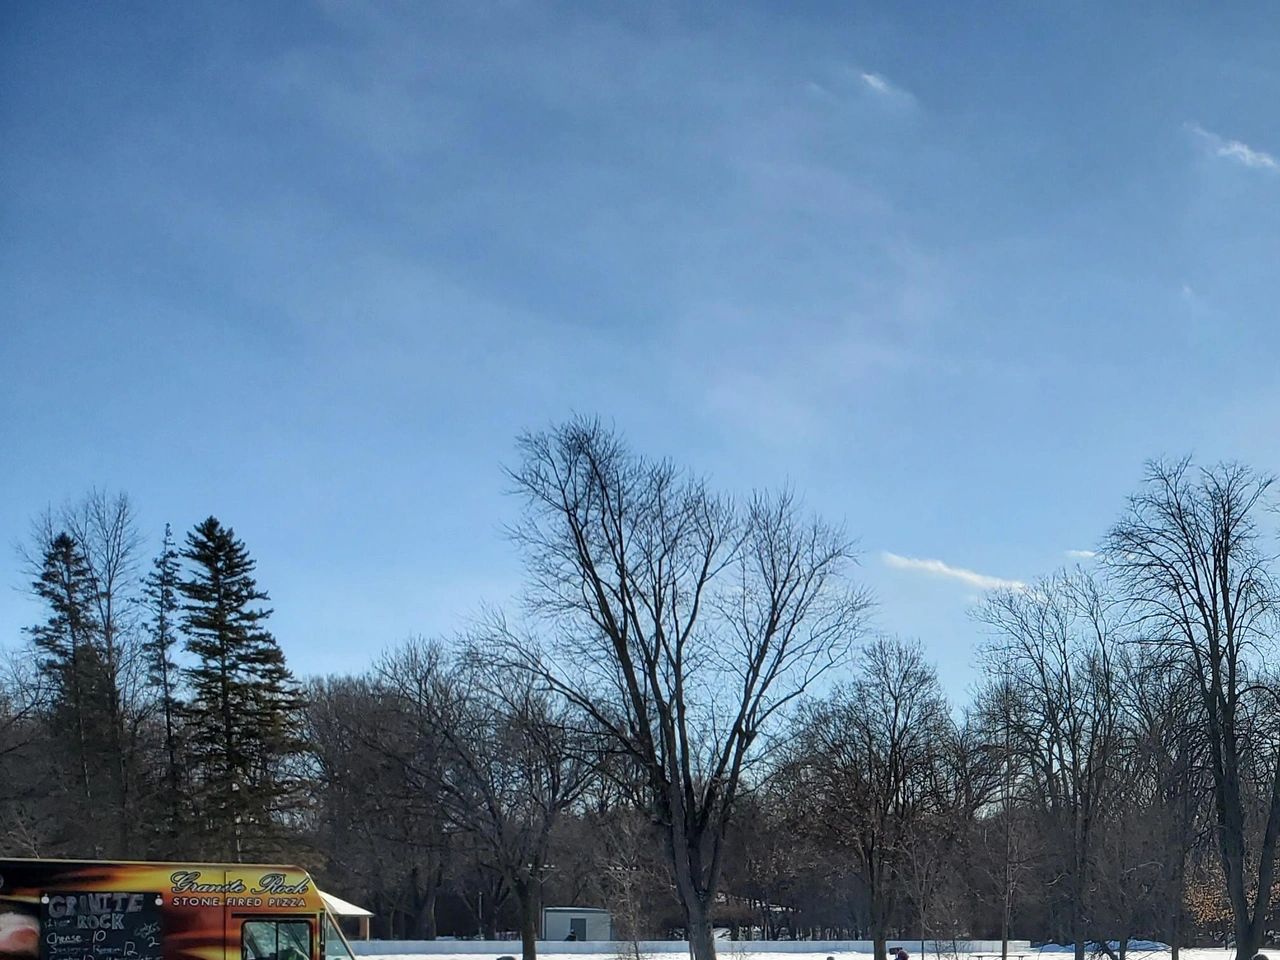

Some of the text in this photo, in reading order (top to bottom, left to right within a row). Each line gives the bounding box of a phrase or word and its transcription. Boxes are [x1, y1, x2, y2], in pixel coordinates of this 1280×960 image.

[170, 871, 310, 894] Granite Rock
[173, 897, 306, 907] STONE FIRED PIZZA
[77, 913, 125, 930] ROCK
[92, 930, 106, 943] 10
